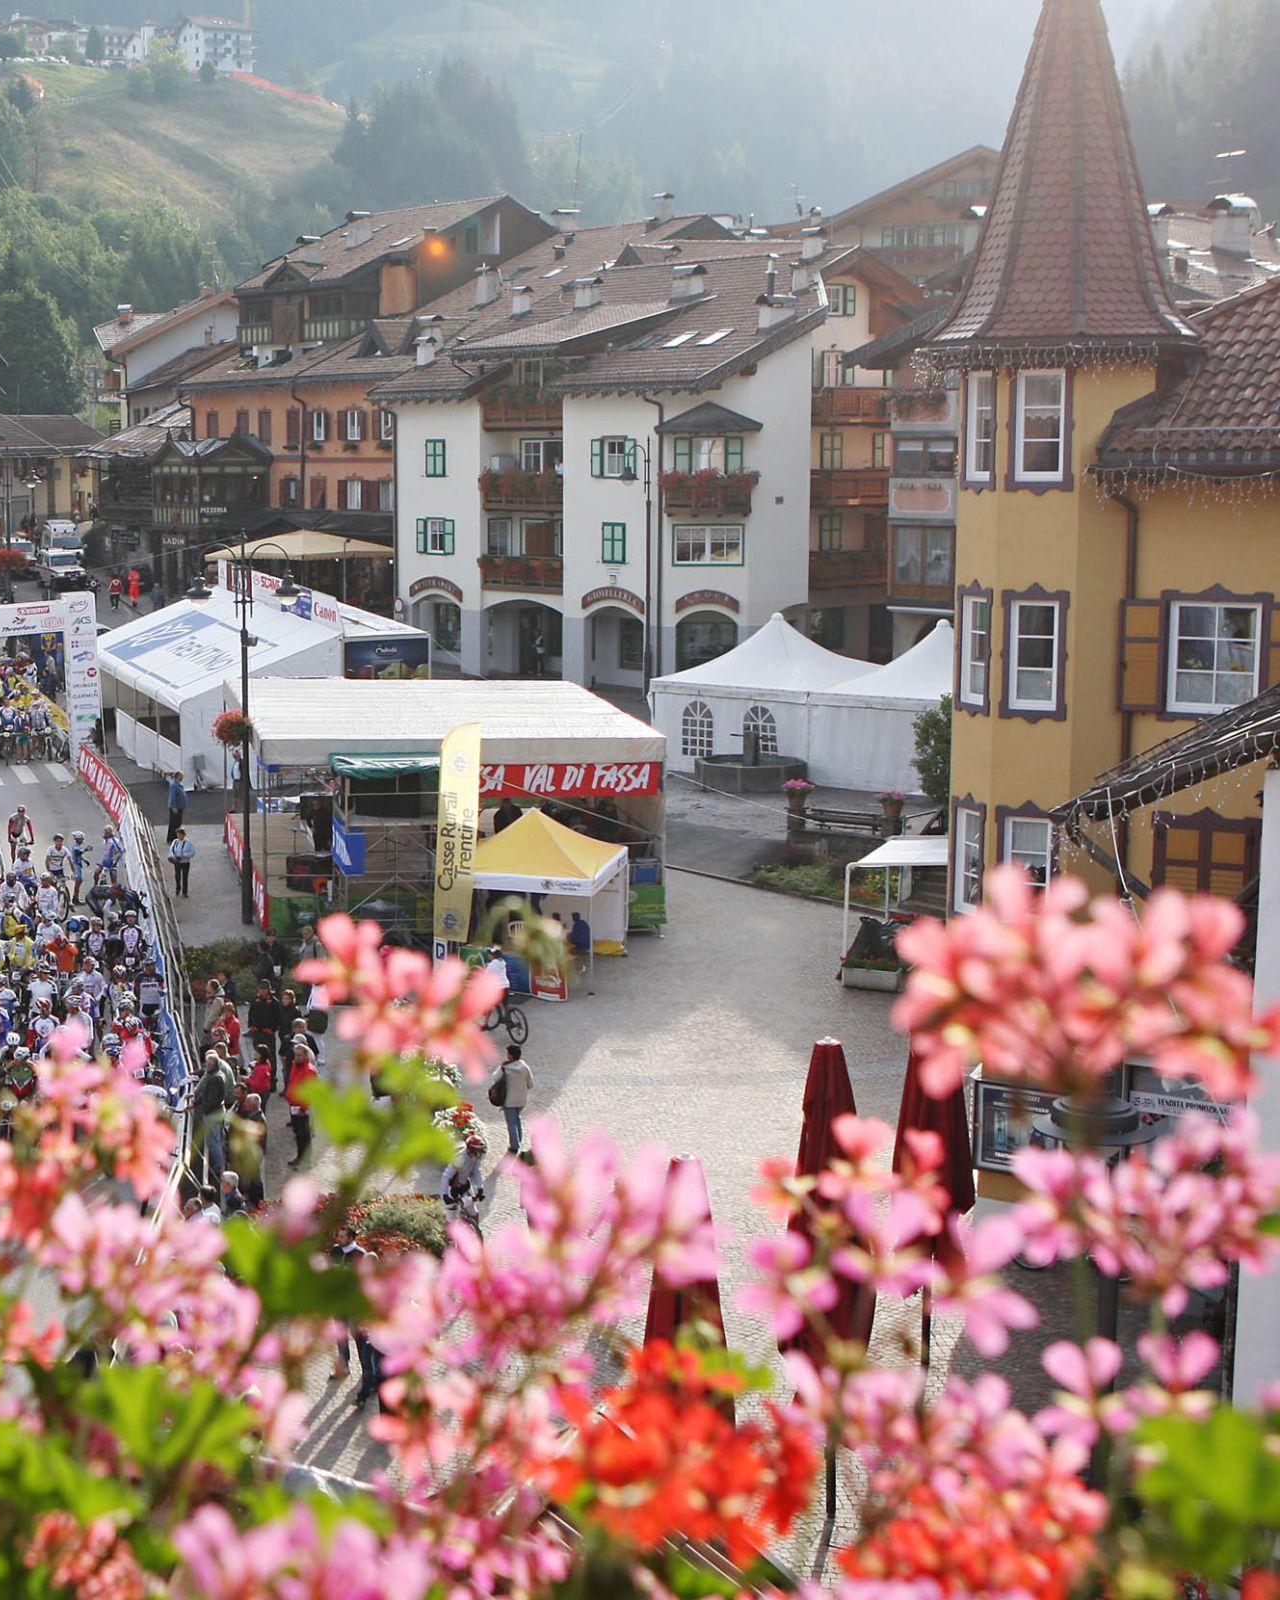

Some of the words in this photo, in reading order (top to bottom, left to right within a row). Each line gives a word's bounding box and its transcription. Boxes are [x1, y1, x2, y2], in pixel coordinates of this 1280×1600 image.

[200, 506, 227, 514] PIZZERIA
[163, 537, 185, 545] LADIN
[587, 588, 637, 607] GIOIELLERIA
[313, 602, 337, 622] Canon
[523, 765, 556, 793] VAL
[592, 764, 651, 792] FASSA
[441, 790, 458, 838] Rurali
[454, 807, 475, 880] Trentine
[437, 841, 455, 892] Casse
[1157, 1098, 1184, 1108] VENDITA
